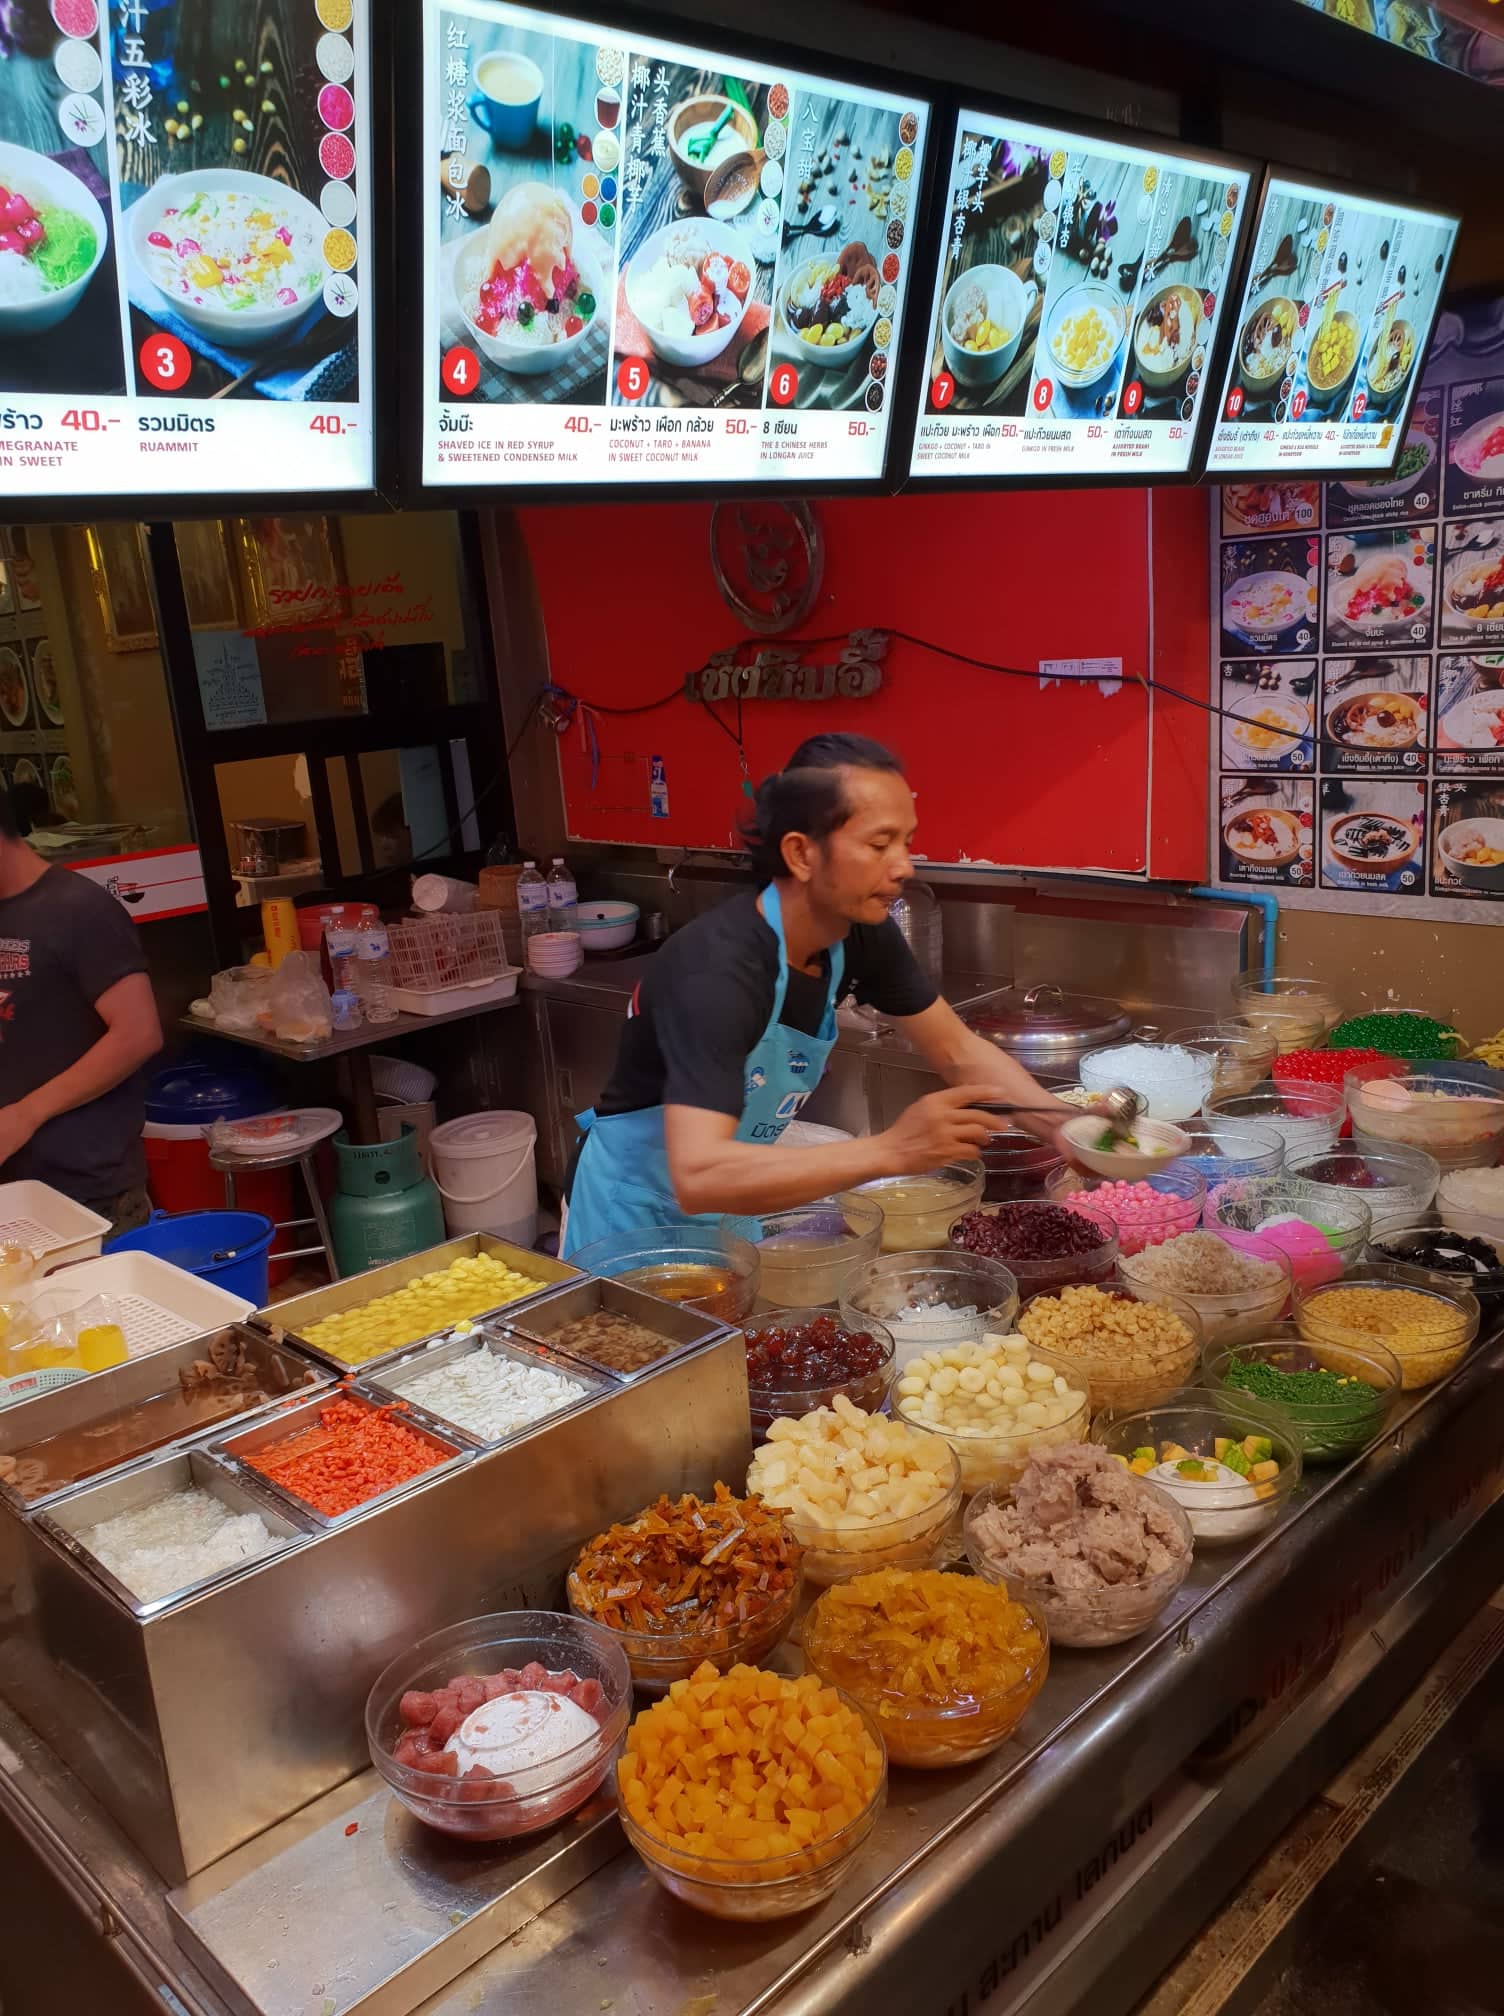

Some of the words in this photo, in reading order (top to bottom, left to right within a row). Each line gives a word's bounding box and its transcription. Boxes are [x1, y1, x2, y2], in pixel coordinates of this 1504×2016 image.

[445, 21, 470, 221] 红糖浆面包冰
[156, 347, 174, 377] 3
[453, 359, 467, 384] 4
[628, 367, 641, 391] 5
[780, 373, 790, 395] 6
[940, 381, 949, 400] 7
[1039, 386, 1048, 404] 8
[1128, 390, 1137, 407] 9
[1229, 395, 1241, 410] 10
[1293, 396, 1305, 412] 11
[1354, 398, 1365, 414] 12
[0, 408, 43, 430] ร้าว
[61, 410, 120, 431] 40.-
[138, 412, 215, 433] รวมมิตร
[309, 415, 357, 434] 40.-
[564, 416, 602, 433] 40.-
[610, 415, 650, 432] มะพร้าว
[656, 415, 682, 432] เผือก
[686, 416, 714, 433] กล้วย
[725, 419, 758, 435] 50.-
[763, 421, 770, 434] 8
[848, 421, 876, 436] 50.-
[952, 424, 980, 437] มะพร้าว
[140, 442, 199, 453] RUAMMIT
[438, 441, 474, 449] SHAVED
[478, 441, 491, 449] ICE
[495, 441, 504, 449] IN
[507, 441, 524, 449] RED
[528, 441, 555, 449] SYRUP
[609, 440, 644, 448] COCONUT
[654, 440, 672, 448] TARO
[681, 440, 711, 448] BANANA
[781, 441, 807, 449] CHINESE
[19, 456, 63, 467] SWEET
[438, 453, 444, 462] &
[449, 453, 500, 462] SWEETENED
[504, 453, 554, 461] CONDENSED
[558, 453, 578, 461] MILK
[608, 453, 616, 462] IN
[619, 453, 643, 462] SWEET
[646, 453, 679, 461] COCONUT
[681, 453, 698, 461] MILK
[1416, 496, 1427, 506] 40
[1296, 509, 1312, 520] 100
[1299, 632, 1309, 641] 40
[1414, 627, 1424, 637] 40
[1292, 753, 1303, 761] 50
[1406, 754, 1417, 762] 40
[1291, 867, 1301, 875] 50
[1402, 874, 1414, 883] 50
